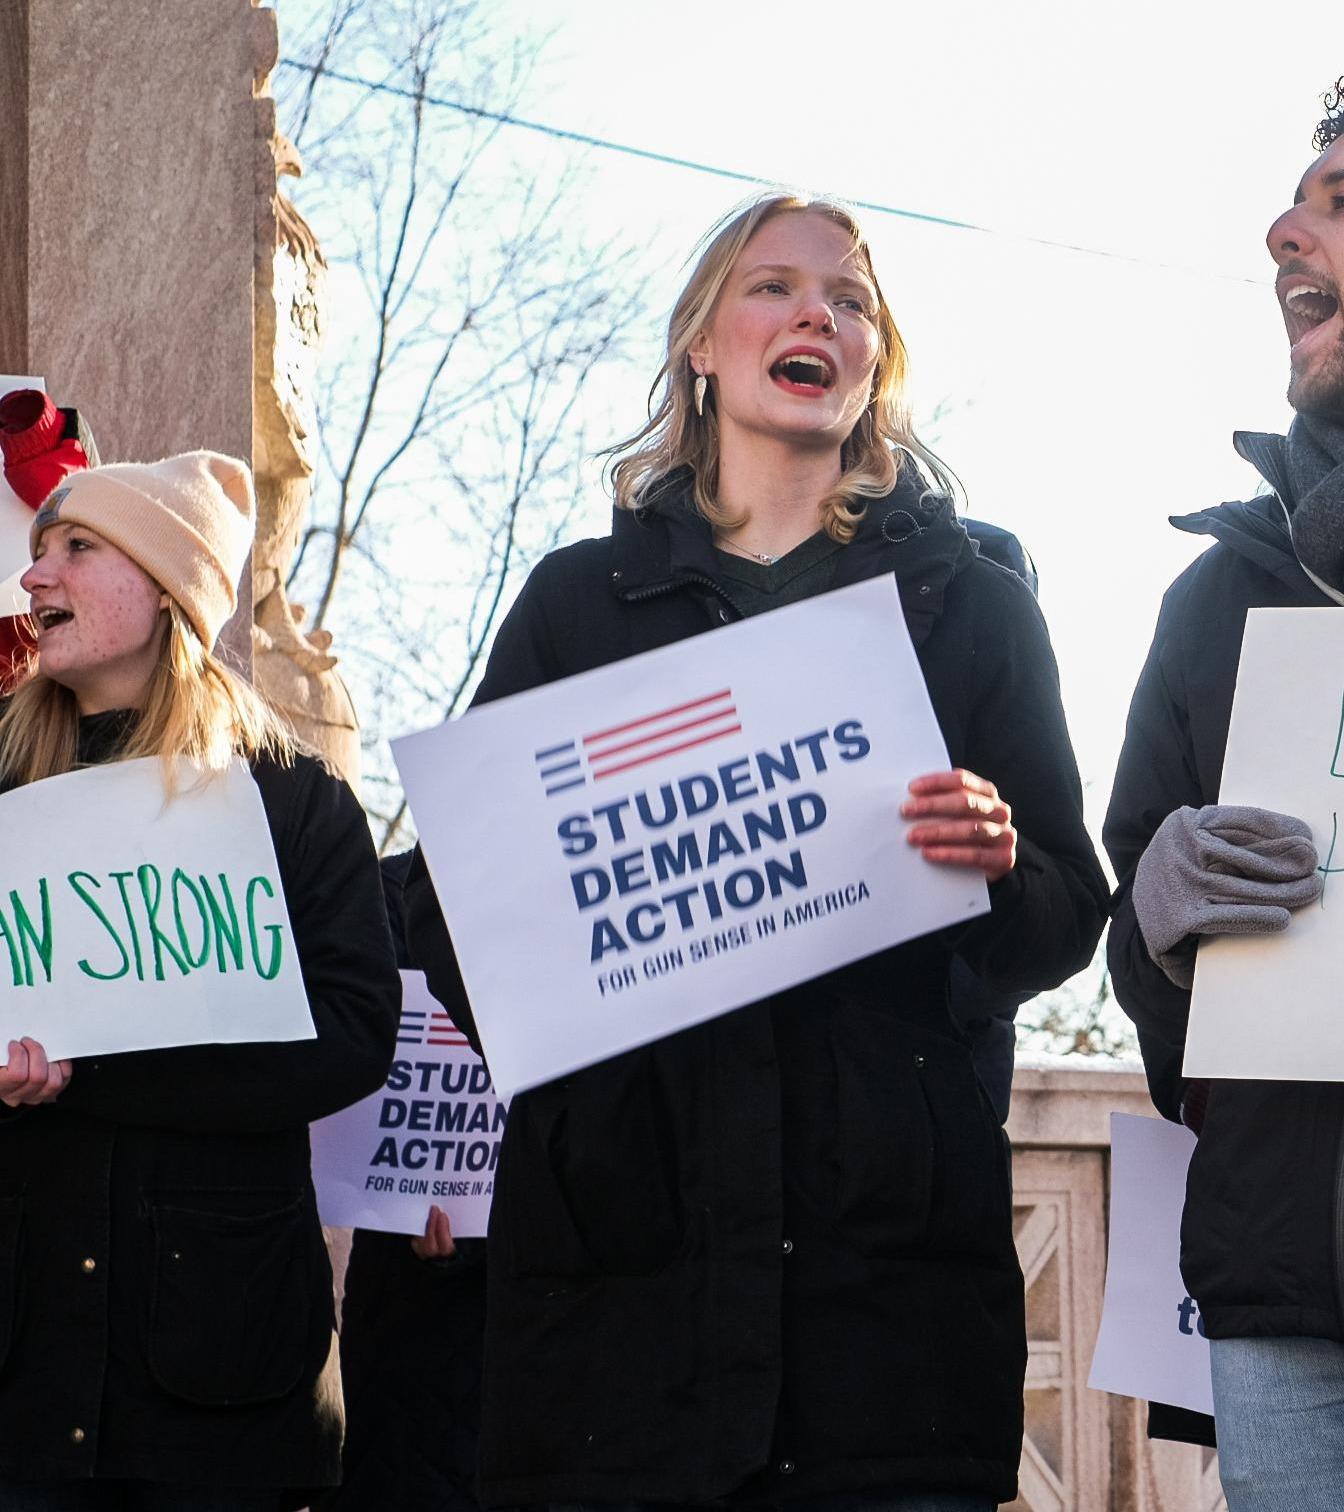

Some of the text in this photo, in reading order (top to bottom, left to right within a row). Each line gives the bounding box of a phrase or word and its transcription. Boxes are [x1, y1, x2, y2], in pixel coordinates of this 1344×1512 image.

[556, 719, 872, 857] STUDENTS
[570, 791, 828, 913] DEMAND
[589, 850, 809, 965] ACTION
[67, 862, 284, 982] STRONG
[597, 879, 871, 997] FOR GUN SENSE IN AMERICA
[364, 1175, 394, 1193] FOR
[398, 1177, 428, 1195] GUN
[431, 1180, 470, 1197] SENSE
[470, 1181, 485, 1196] IN
